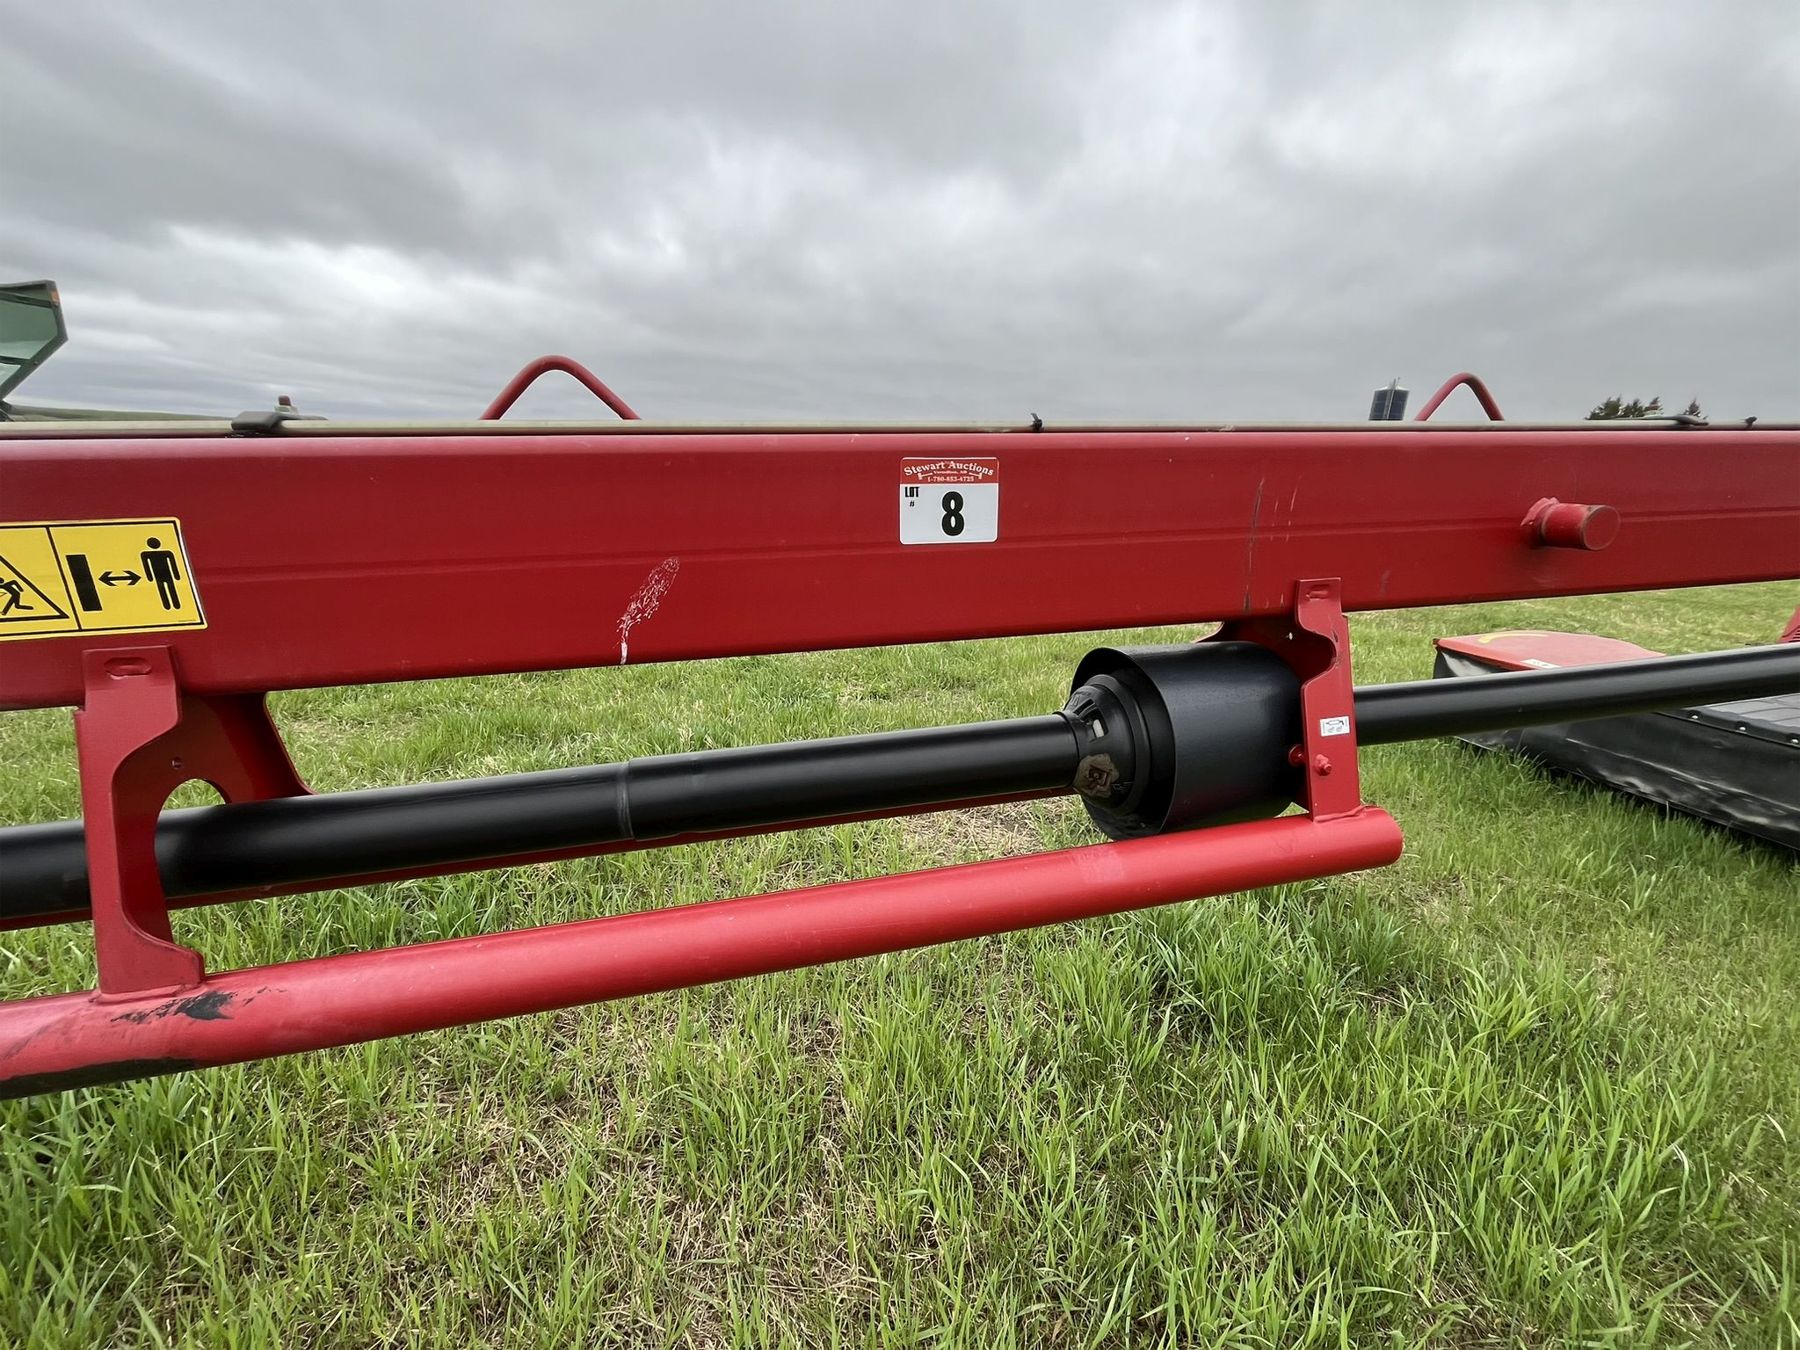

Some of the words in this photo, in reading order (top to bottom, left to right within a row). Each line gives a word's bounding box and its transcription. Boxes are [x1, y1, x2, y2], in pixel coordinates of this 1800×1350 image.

[904, 461, 945, 476] Stewart
[949, 460, 994, 475] Auctions
[904, 486, 920, 498] LOT
[941, 491, 965, 537] 8
